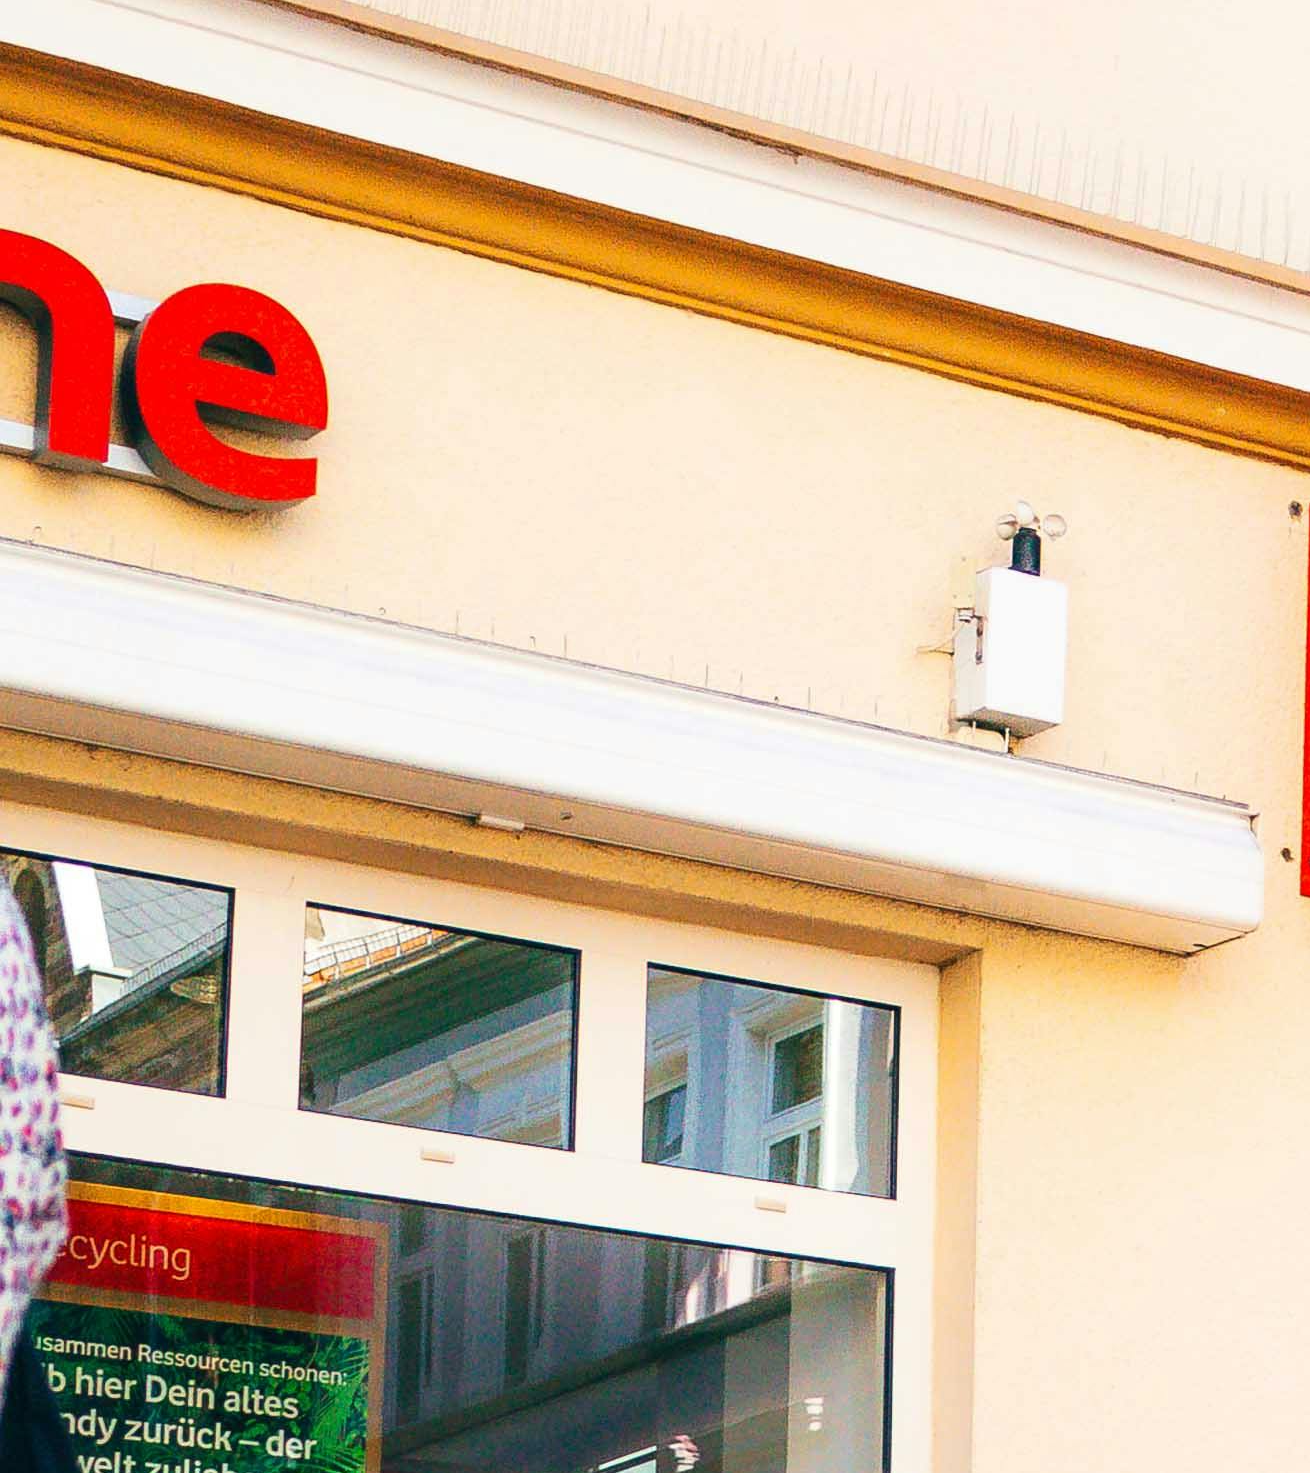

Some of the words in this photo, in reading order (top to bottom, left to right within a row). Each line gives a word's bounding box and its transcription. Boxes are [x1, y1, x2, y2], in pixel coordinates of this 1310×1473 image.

[138, 1343, 254, 1375] Ressourcen
[259, 1360, 348, 1387] schonen:
[75, 1367, 137, 1401] hier
[145, 1373, 215, 1410] Dein
[224, 1385, 300, 1419] altes
[124, 1417, 233, 1452] zurück
[266, 1428, 317, 1460] der
